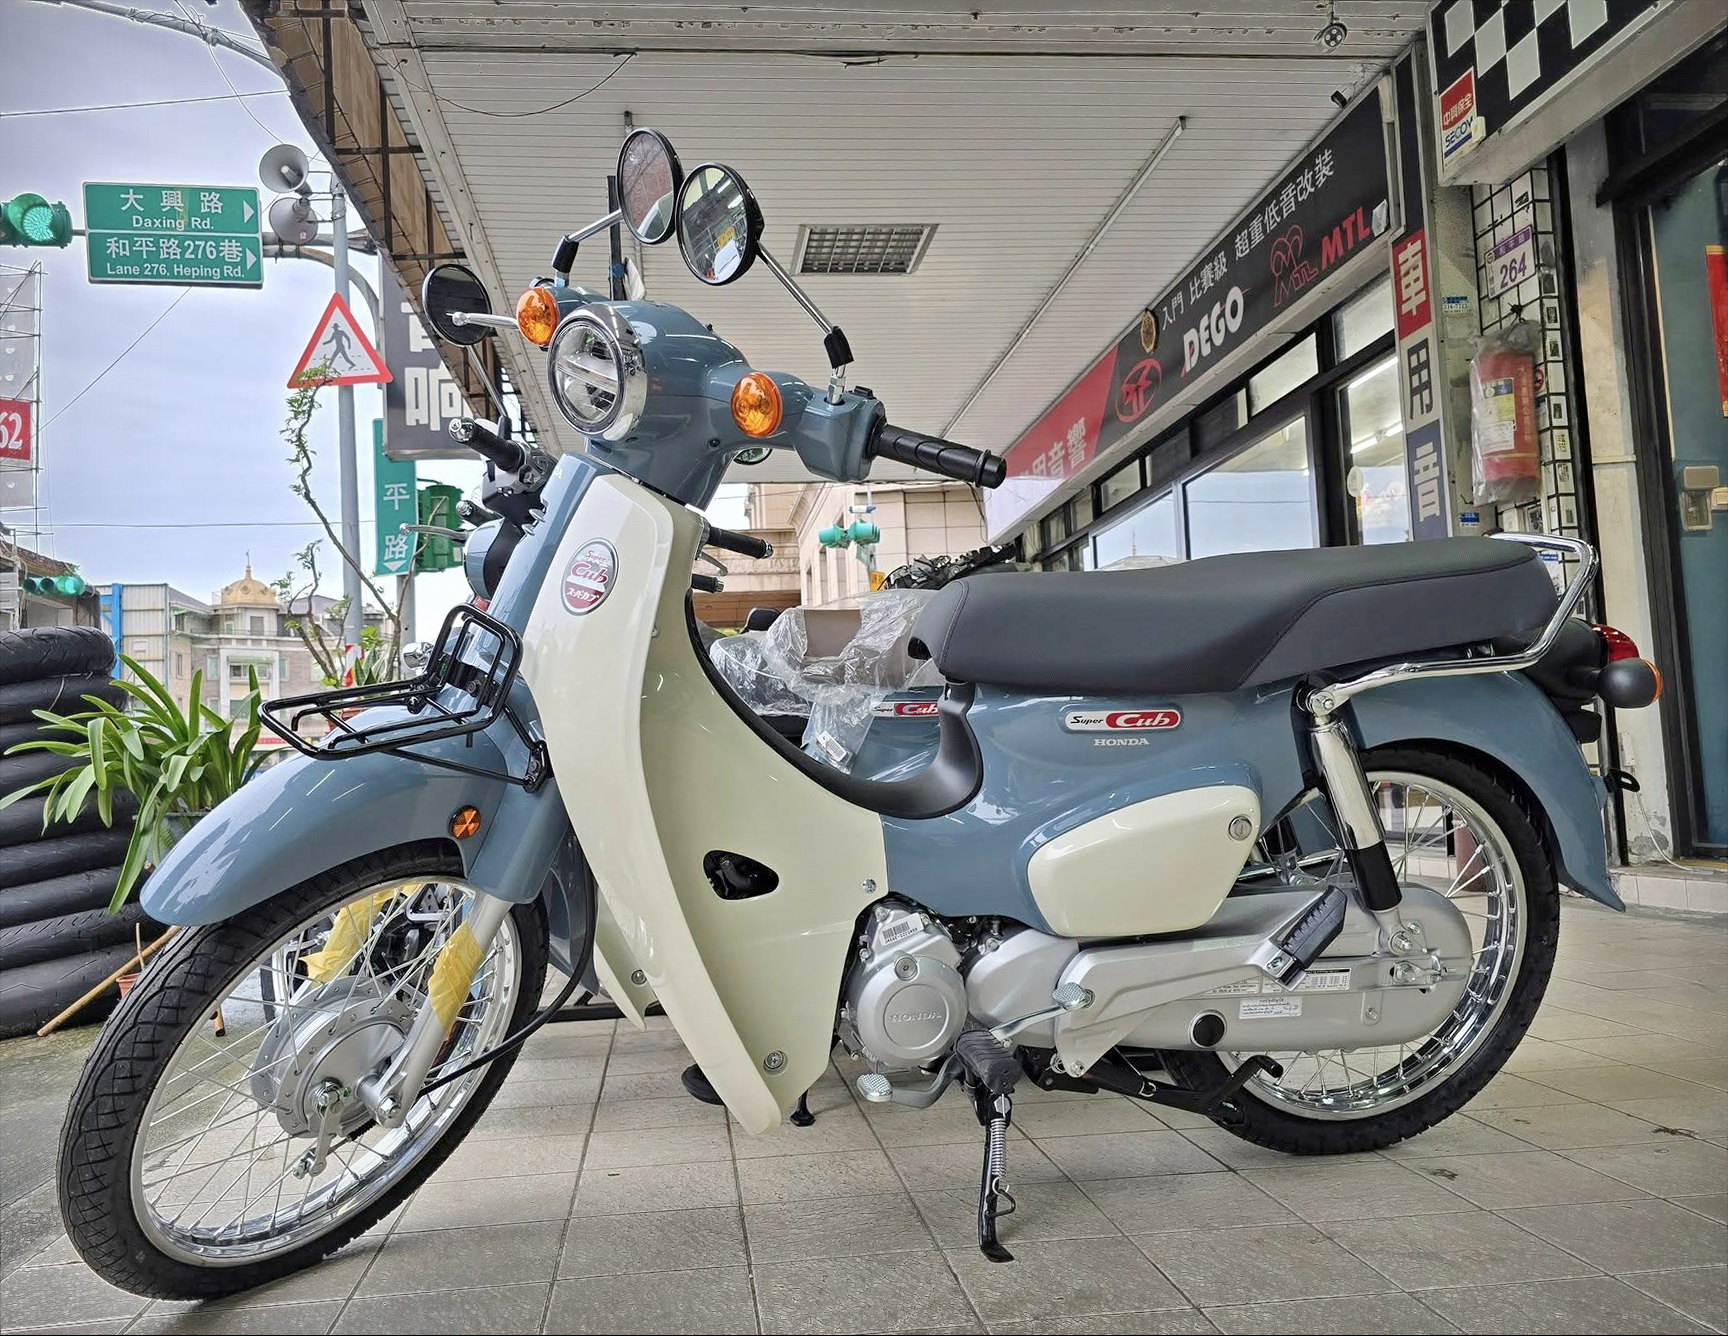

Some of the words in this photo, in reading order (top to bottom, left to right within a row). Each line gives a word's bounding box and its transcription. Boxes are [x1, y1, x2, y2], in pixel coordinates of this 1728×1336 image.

[120, 188, 224, 214] 大興路
[132, 216, 185, 231] Daxing
[191, 217, 214, 230] Rd.
[1162, 291, 1185, 331] 入門
[1189, 250, 1228, 305] 比賽級
[1235, 149, 1334, 260] 超重低音改裝
[1321, 206, 1371, 271] MTL
[106, 237, 243, 263] 和平路276巷
[107, 263, 140, 275] Lane
[174, 264, 221, 279] Heping
[224, 265, 245, 278] Rd.
[1500, 251, 1527, 290] 264
[1183, 286, 1245, 374] DEGO
[1021, 416, 1087, 479] 用音響
[585, 550, 607, 562] Super
[571, 562, 609, 583] Cub
[902, 703, 939, 714] Cub
[1070, 715, 1104, 725] Super
[1115, 712, 1170, 727] Cub
[1093, 738, 1150, 746] HONDA
[890, 1011, 942, 1023] HONDA
